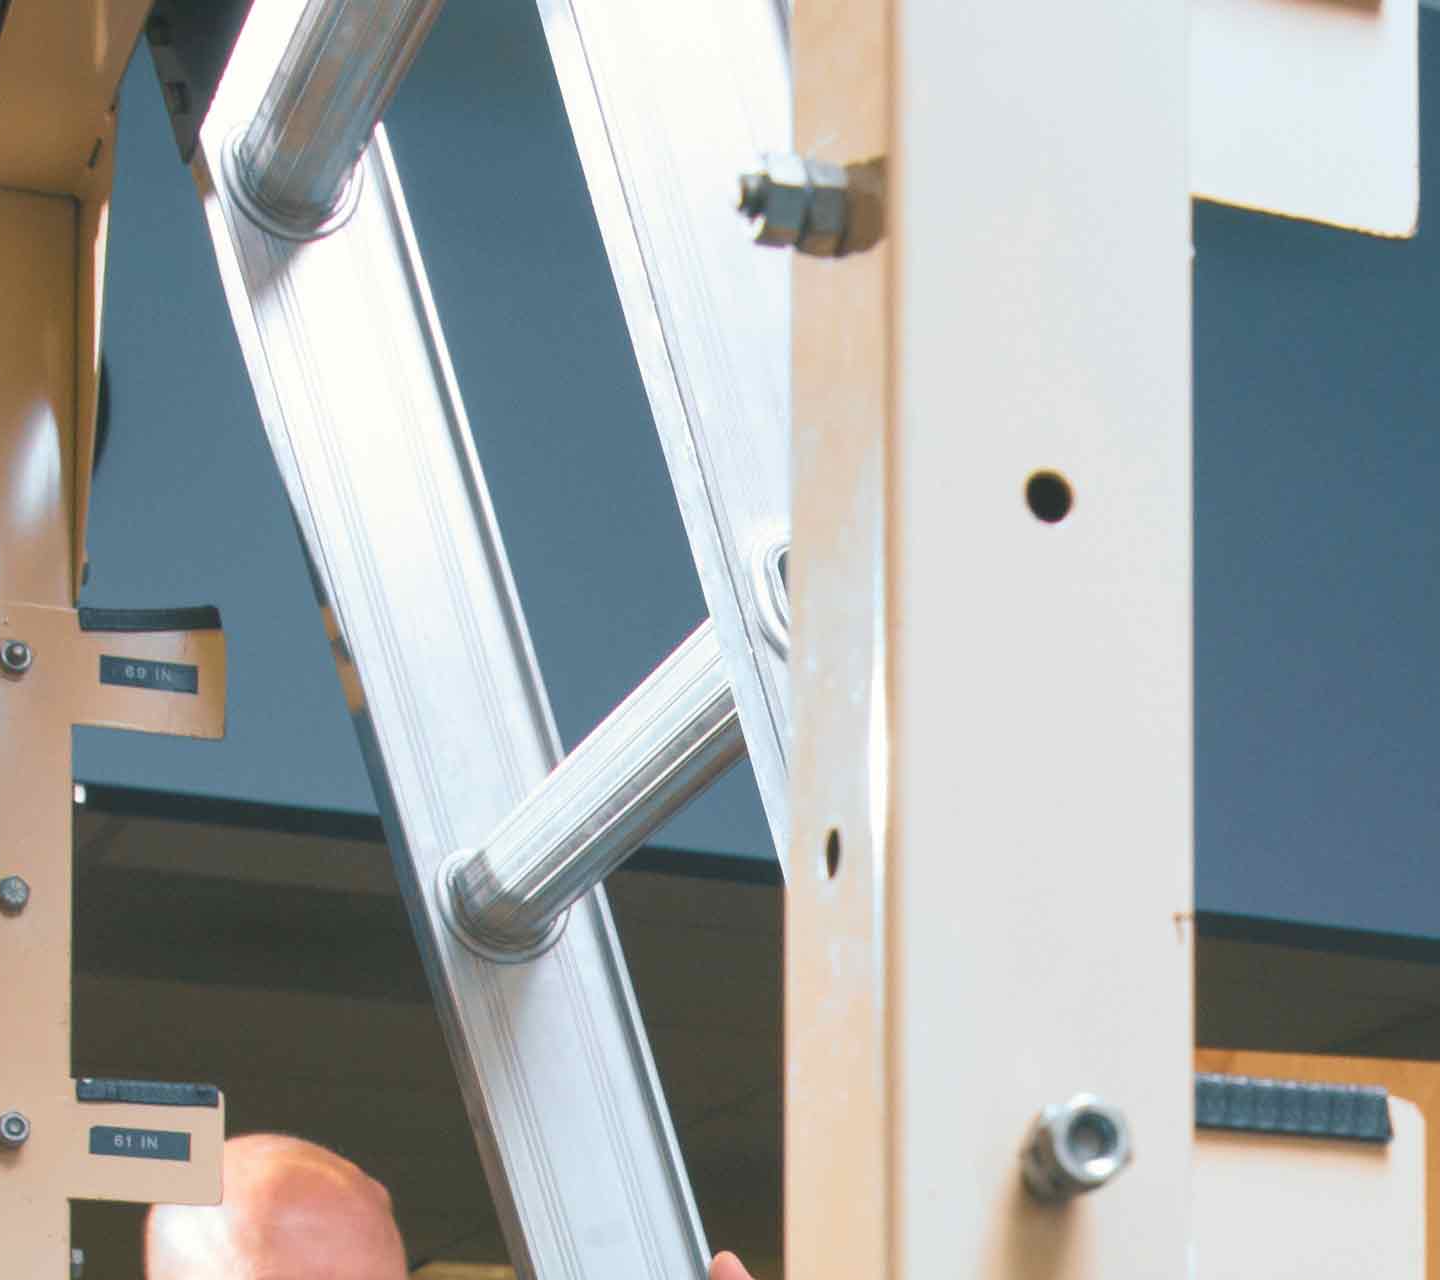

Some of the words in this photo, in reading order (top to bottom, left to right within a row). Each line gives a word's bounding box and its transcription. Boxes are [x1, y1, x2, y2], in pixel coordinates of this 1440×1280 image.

[155, 667, 171, 681] IN
[114, 1134, 132, 1147] 61
[141, 1135, 158, 1149] IN
